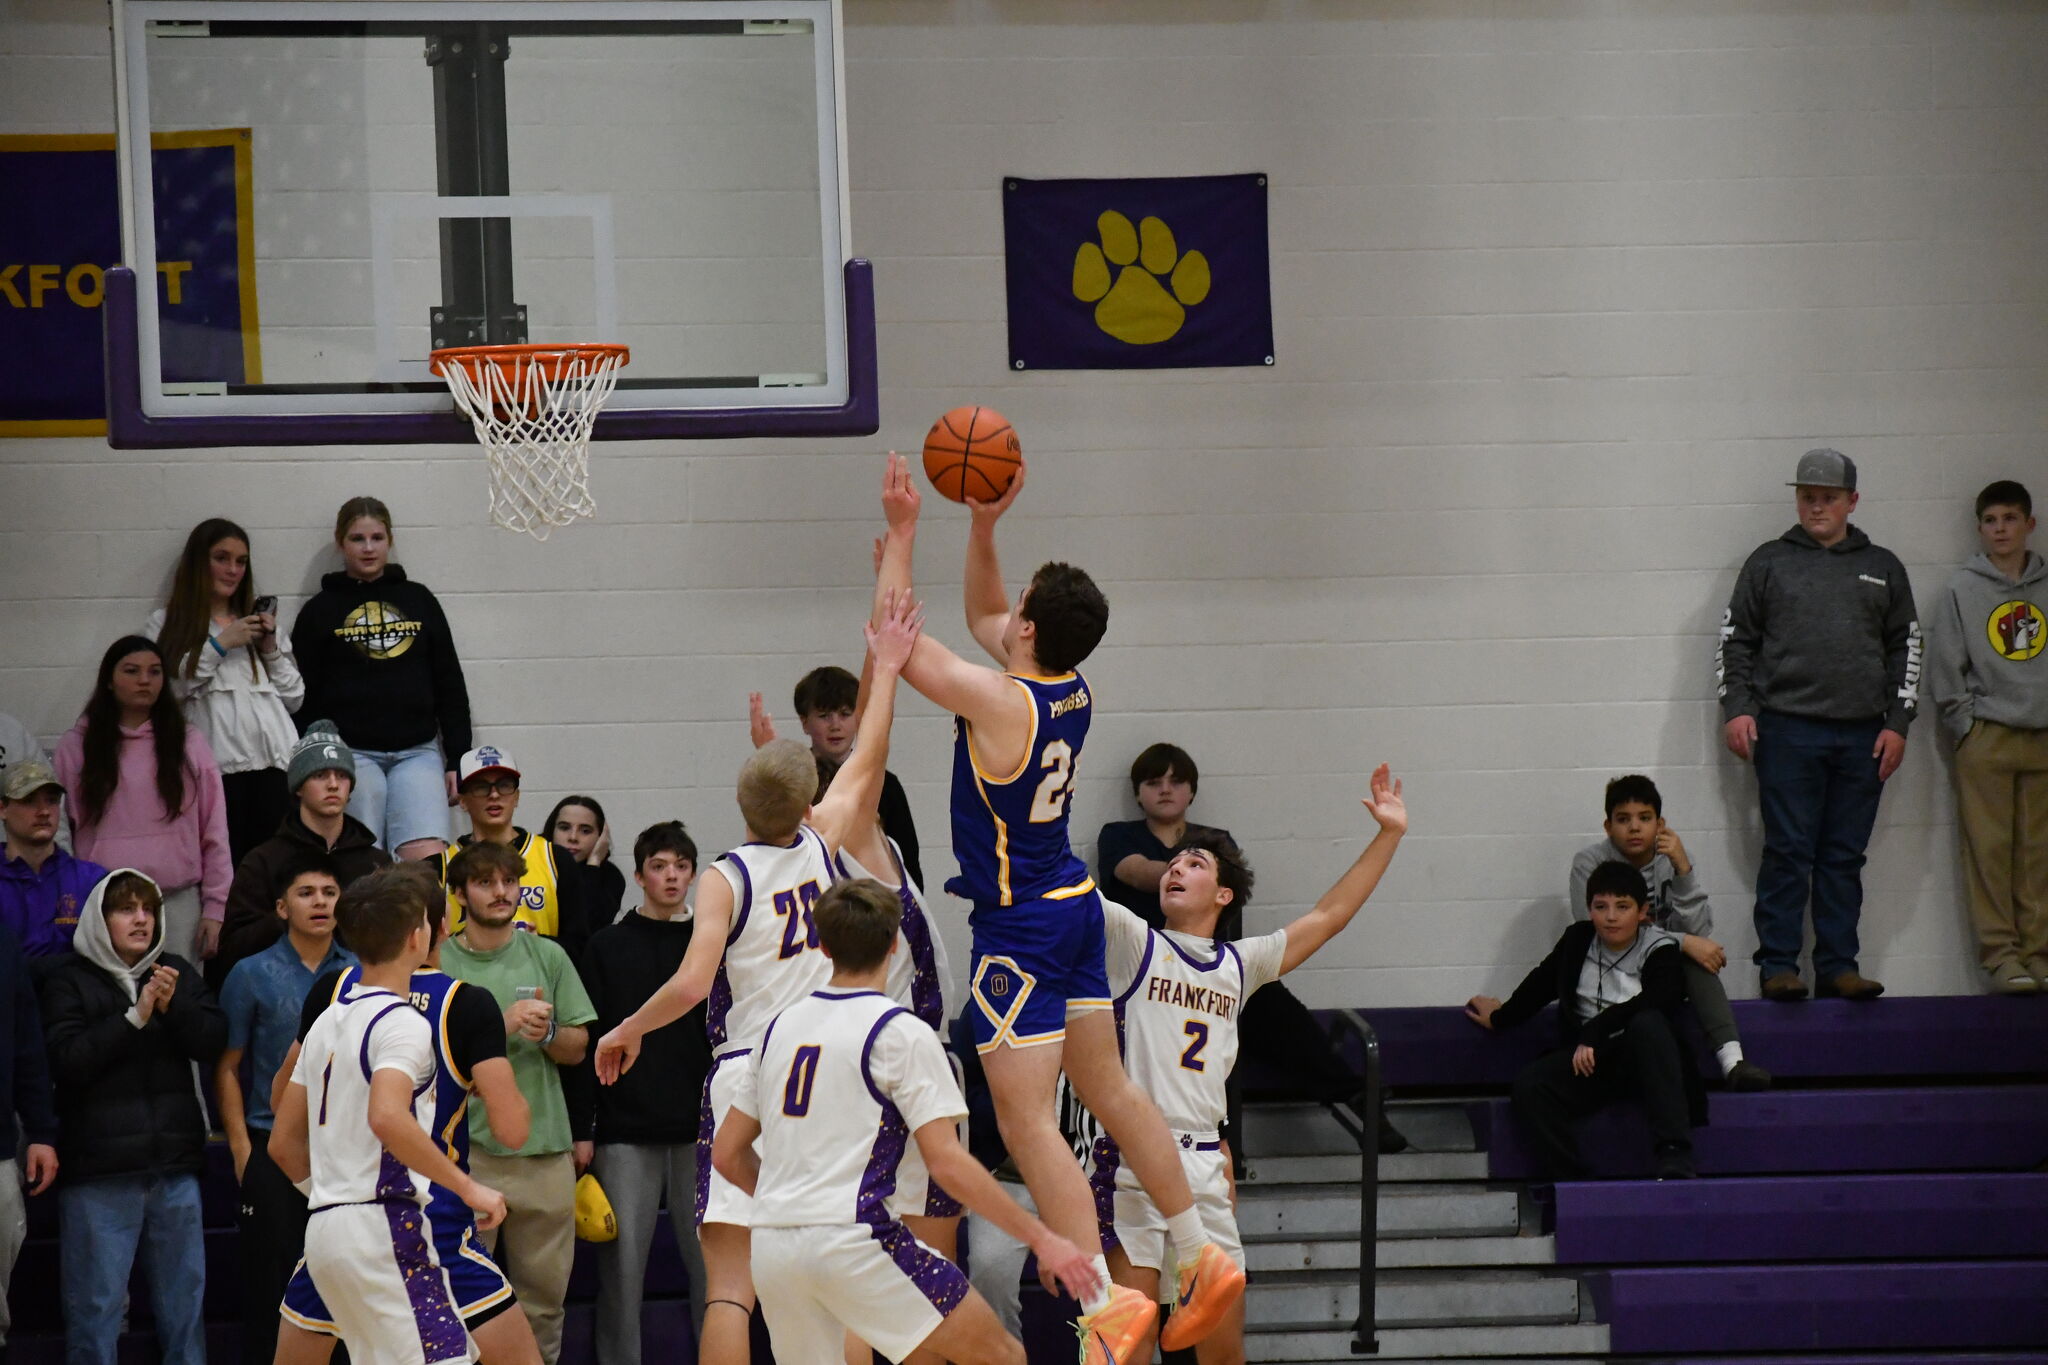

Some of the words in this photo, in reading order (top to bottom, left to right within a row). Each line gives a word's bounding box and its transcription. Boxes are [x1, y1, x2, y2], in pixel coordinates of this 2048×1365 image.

[0, 261, 192, 308] KFOT
[1148, 976, 1237, 1022] FRANKFORT
[1179, 1018, 1209, 1074] 2
[319, 1052, 334, 1127] 1
[782, 1044, 822, 1119] 0
